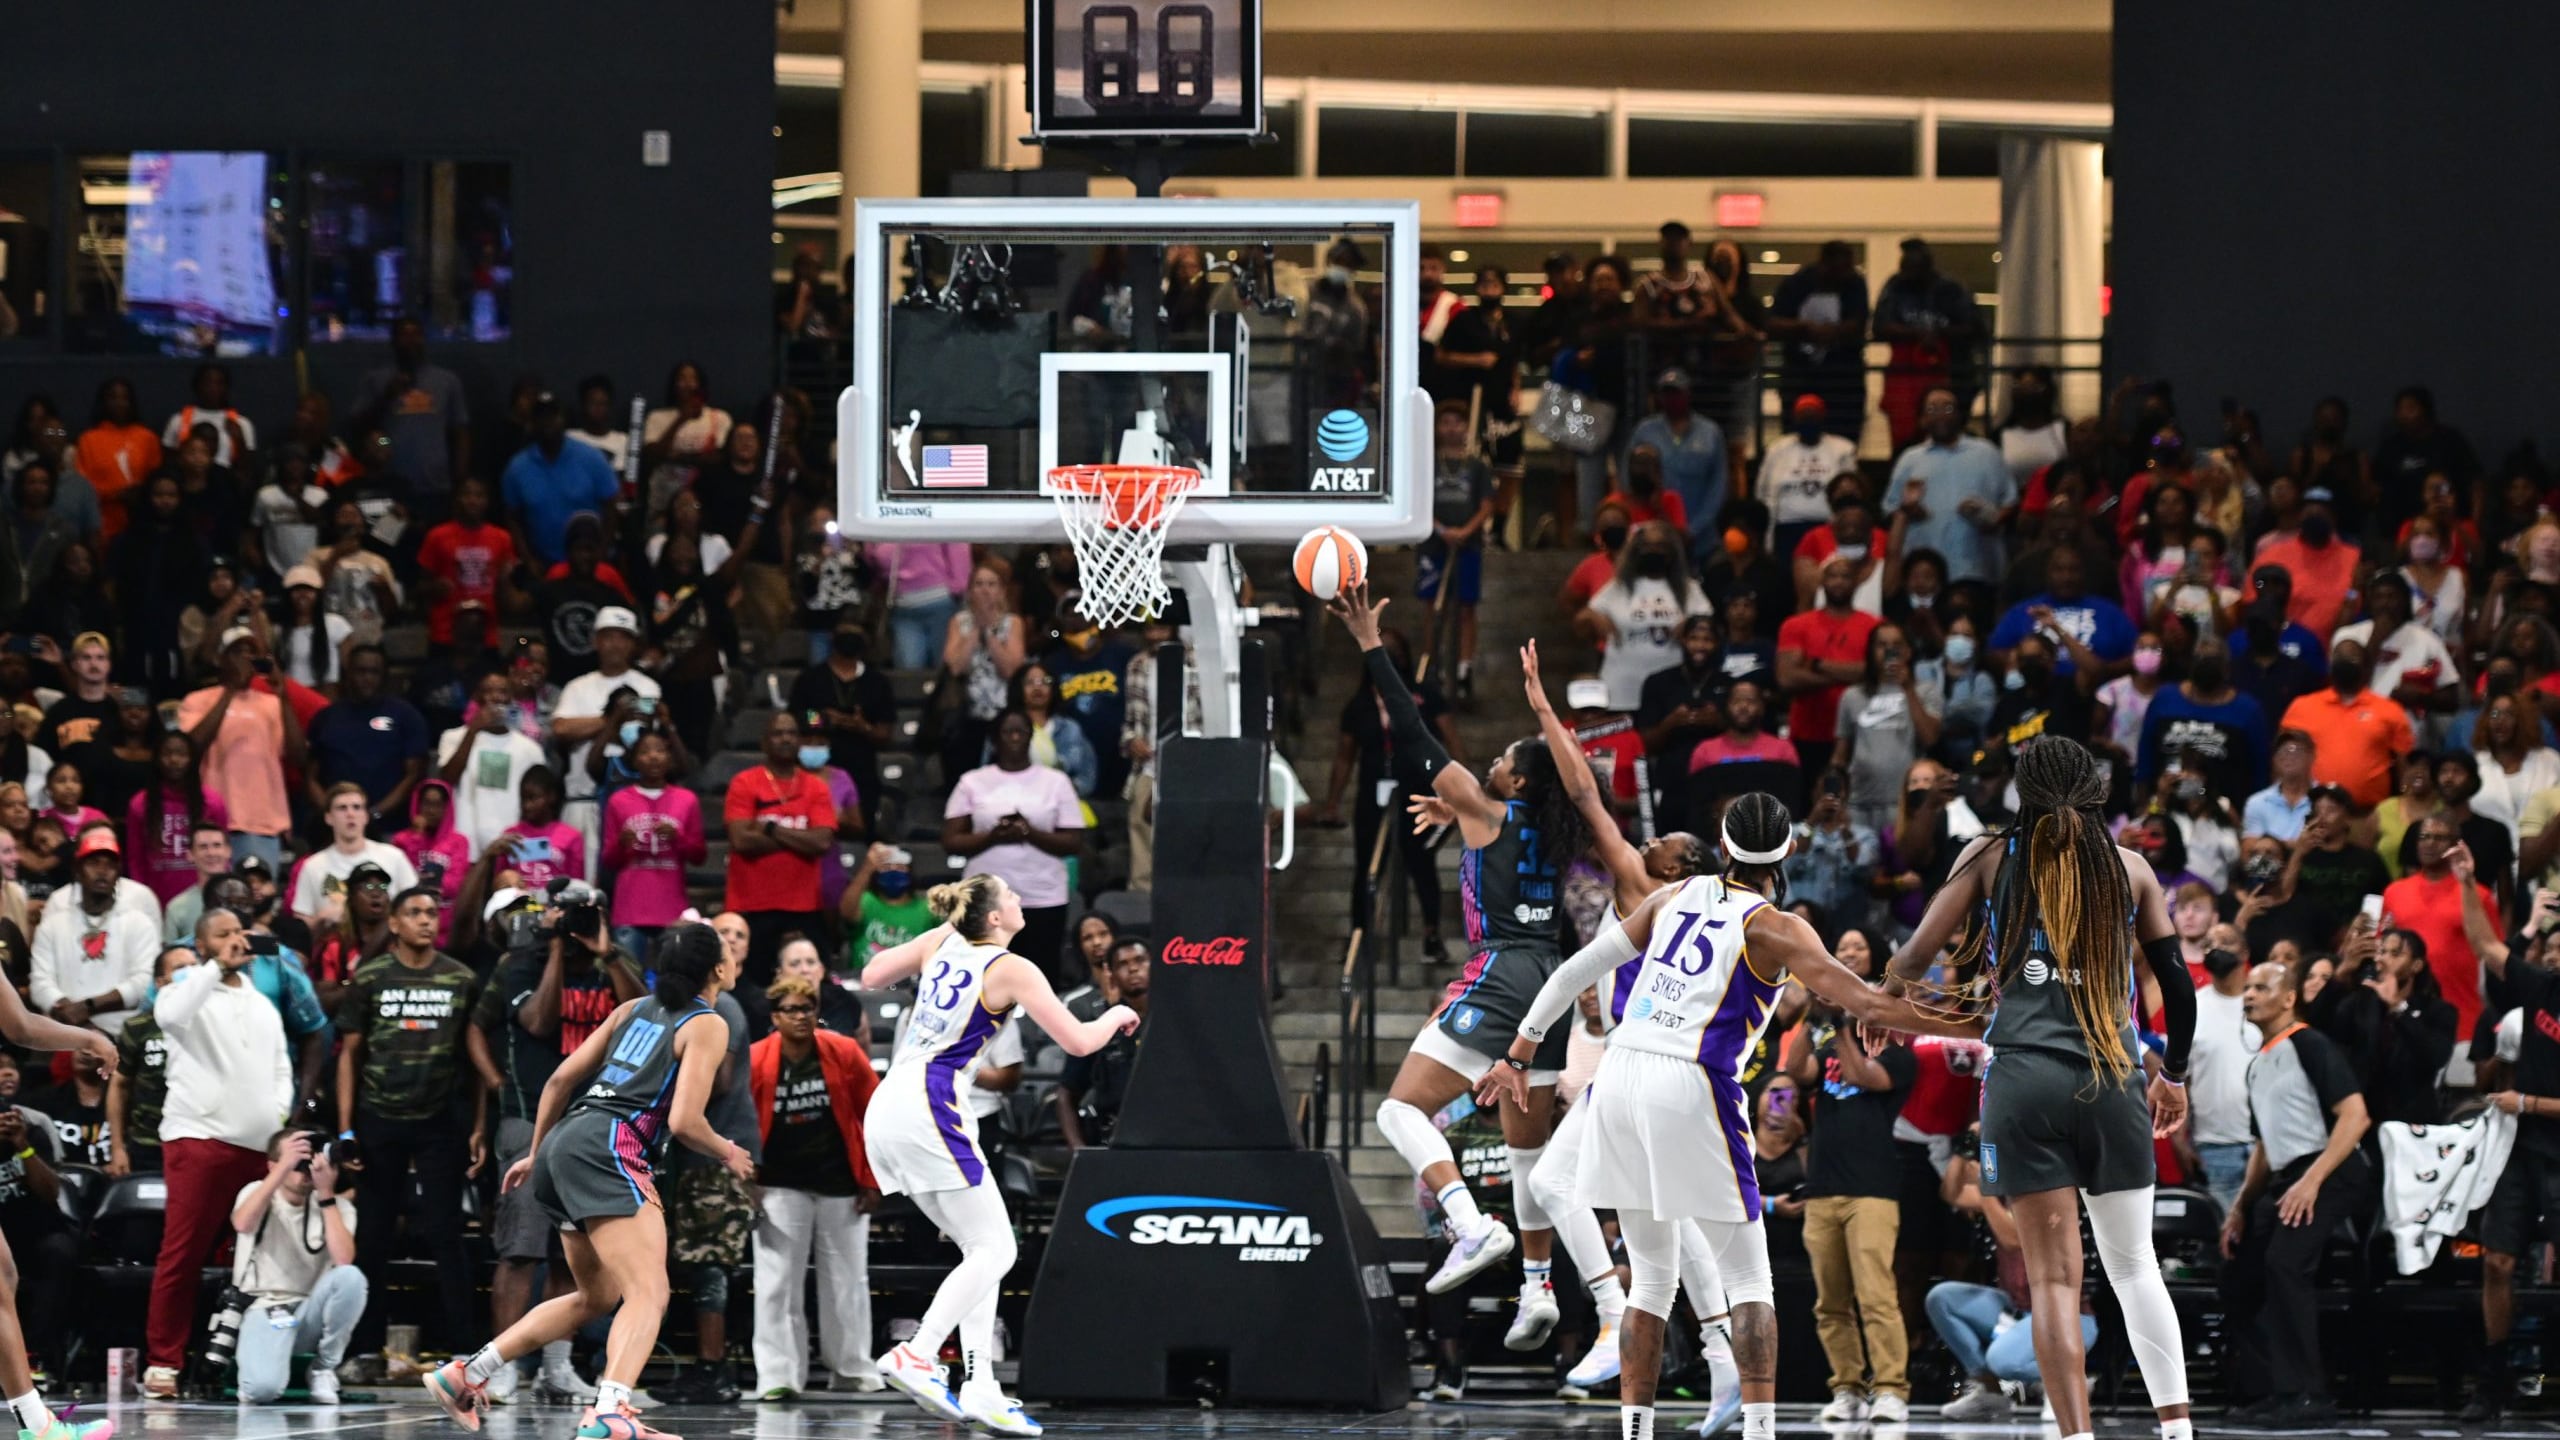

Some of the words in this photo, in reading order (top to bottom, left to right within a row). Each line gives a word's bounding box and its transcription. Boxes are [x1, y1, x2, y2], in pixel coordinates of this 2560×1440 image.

[1310, 467, 1375, 491] AT&T
[879, 506, 932, 517] SPALDING
[1653, 911, 1728, 976] 15
[381, 989, 406, 1002] AN
[407, 989, 453, 1002] ARMY
[922, 960, 973, 1011] 33
[1651, 972, 1686, 1002] SYKES
[380, 1003, 401, 1017] OF
[1649, 1009, 1686, 1029] AT&T
[612, 1017, 666, 1068] 00
[1129, 1214, 1312, 1245] SCANA
[1239, 1247, 1312, 1262] ENERGY
